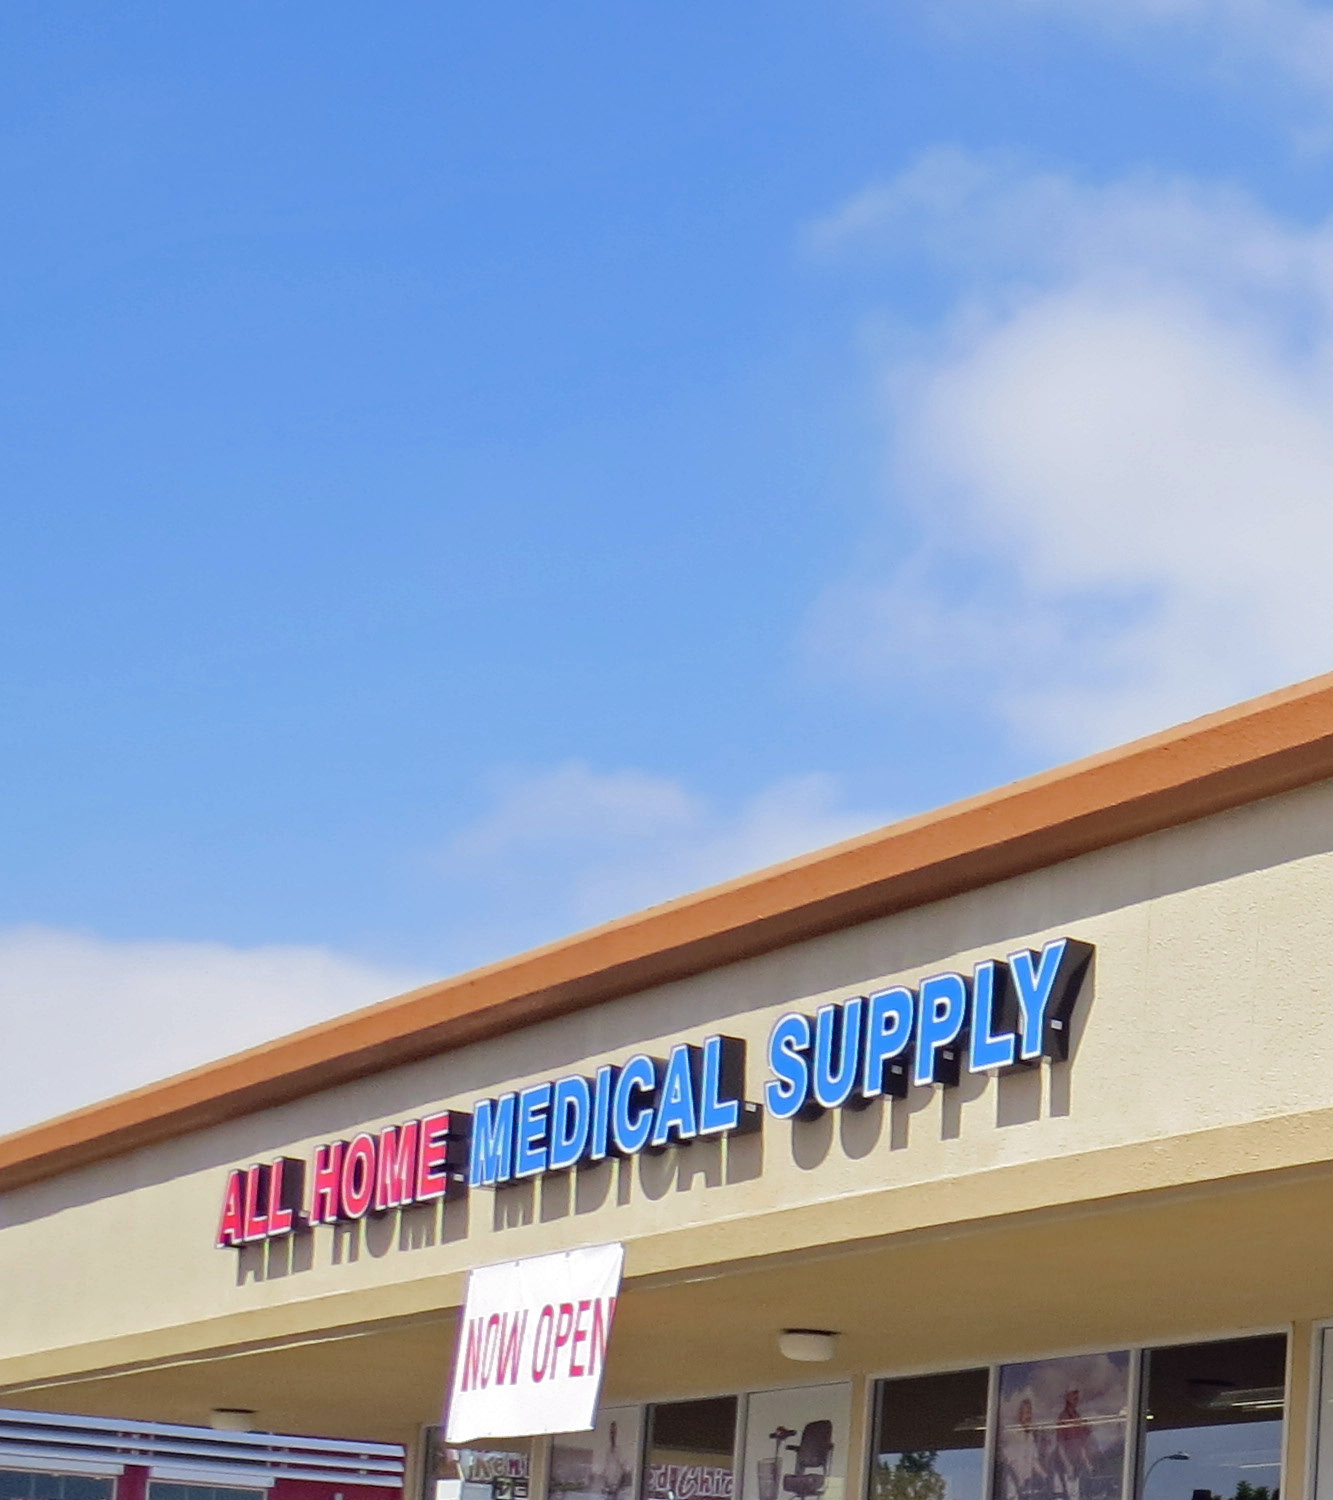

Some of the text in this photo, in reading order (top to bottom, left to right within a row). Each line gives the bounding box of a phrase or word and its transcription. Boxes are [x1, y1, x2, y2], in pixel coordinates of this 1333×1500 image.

[216, 937, 1069, 1248] ALL HOME MEDICAL SUPPLY
[460, 1296, 617, 1392] NOW OPEN
